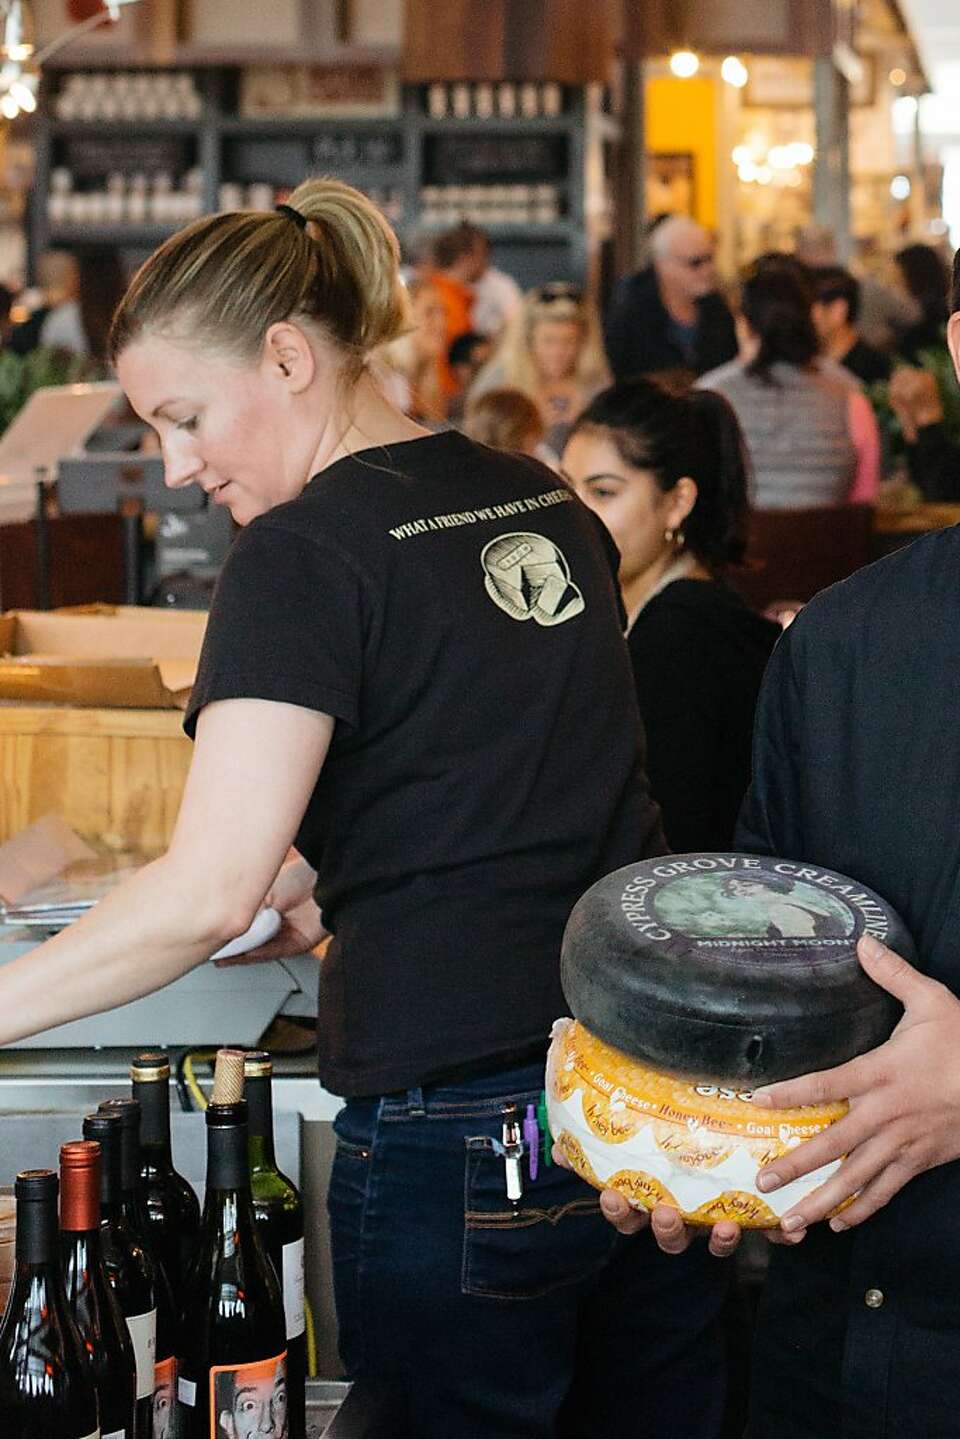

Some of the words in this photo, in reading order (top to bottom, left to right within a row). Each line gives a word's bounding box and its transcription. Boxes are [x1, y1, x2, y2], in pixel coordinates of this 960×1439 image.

[389, 518, 427, 541] WHAT
[426, 518, 438, 530] A
[434, 511, 477, 529] FRIEND
[474, 507, 497, 521] WE
[493, 500, 526, 518] HAVE
[524, 497, 540, 511] IN
[621, 875, 673, 941] CYPRESS
[653, 857, 762, 878] GROVE
[774, 863, 889, 941] CREAMLINE
[695, 938, 787, 948] MIDNIGHT
[791, 937, 850, 947] MOON
